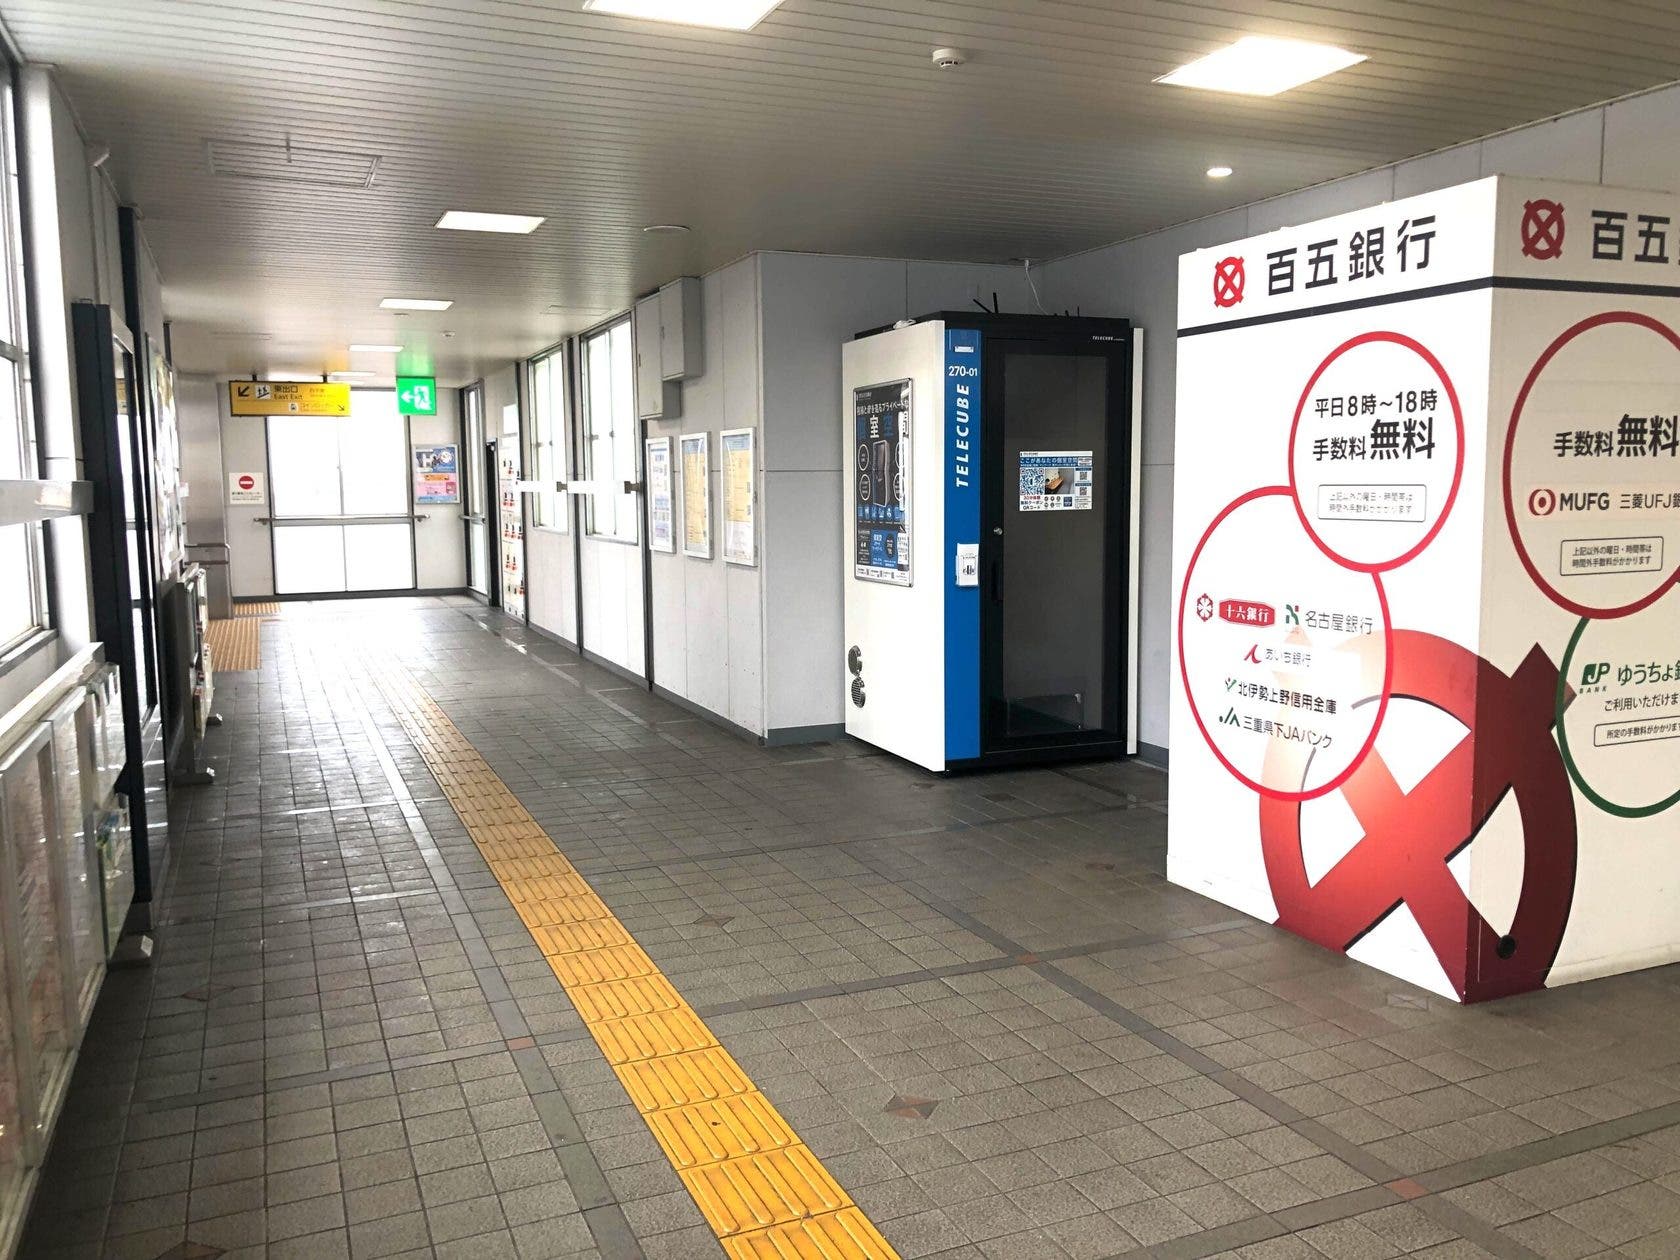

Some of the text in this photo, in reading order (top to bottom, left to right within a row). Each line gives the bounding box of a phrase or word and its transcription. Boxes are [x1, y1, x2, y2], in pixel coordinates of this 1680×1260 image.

[1591, 209, 1680, 265] 百五
[1266, 215, 1436, 296] 百五銀行
[948, 365, 978, 377] 270-01
[956, 383, 970, 488] TELECUBE
[1312, 416, 1436, 461] 手数料無料
[1553, 413, 1680, 458] 手数料無料
[1559, 492, 1610, 511] MUFG
[1226, 604, 1373, 635] 十六銀行 名古屋銀行
[1238, 682, 1337, 715] 北伊勢上野信用金庫
[1579, 685, 1607, 694] BANK
[1243, 715, 1333, 749] 三重県下JAバンク
